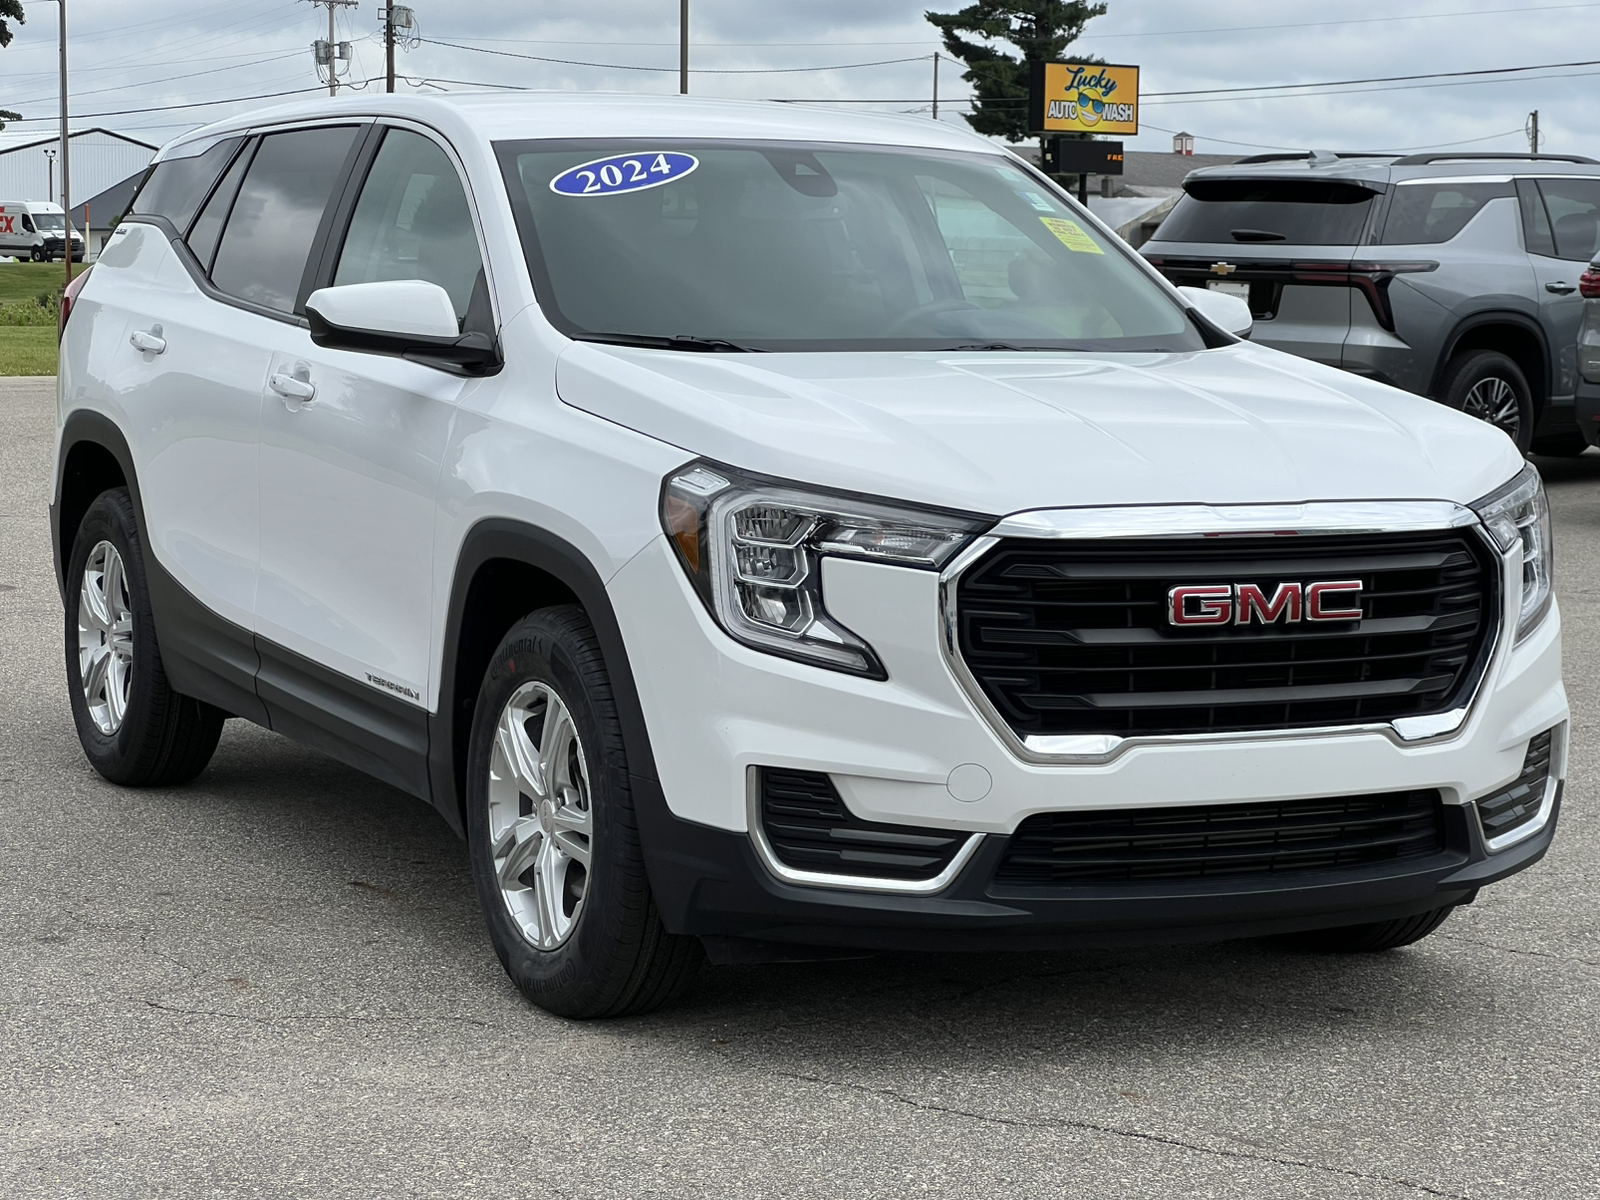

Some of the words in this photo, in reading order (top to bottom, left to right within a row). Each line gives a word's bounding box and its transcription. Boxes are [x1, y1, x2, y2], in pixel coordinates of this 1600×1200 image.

[1064, 67, 1117, 97] Lucky
[1047, 100, 1078, 120] AUTO
[1102, 103, 1134, 122] WASH
[576, 153, 672, 193] 2024
[1168, 580, 1363, 626] GMC
[490, 635, 537, 680] Continental
[364, 671, 420, 701] TERRAIN
